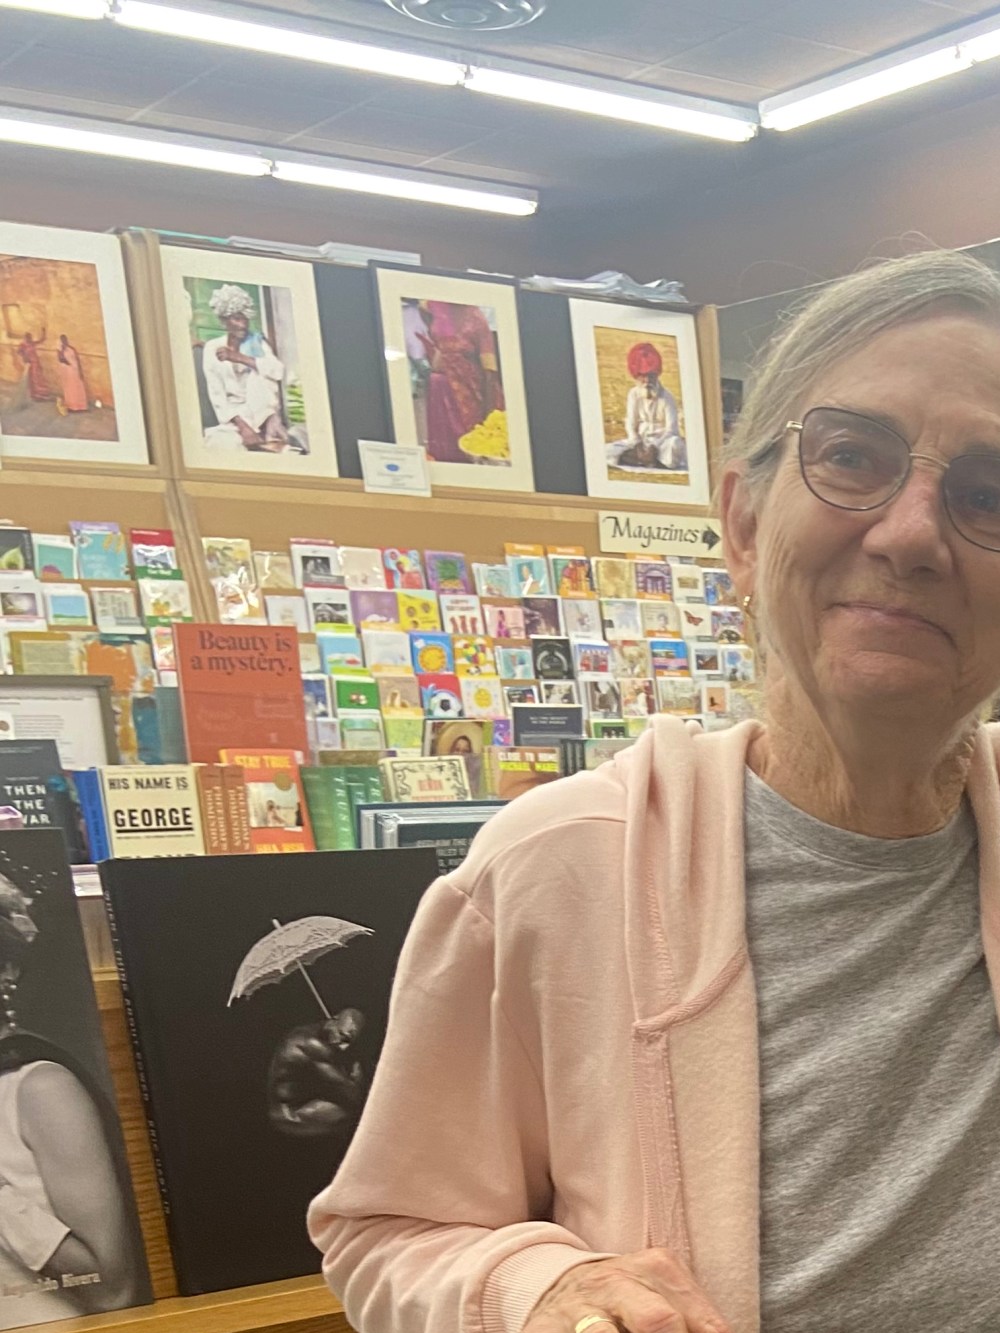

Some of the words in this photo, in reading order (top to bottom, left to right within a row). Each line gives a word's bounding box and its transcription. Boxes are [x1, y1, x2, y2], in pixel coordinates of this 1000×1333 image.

[602, 516, 700, 548] Magazines
[198, 630, 269, 656] Beauty
[274, 632, 292, 652] is
[190, 655, 203, 670] a
[207, 655, 293, 677] mystery.
[234, 756, 260, 768] STAY
[264, 755, 292, 769] TRUE
[3, 784, 47, 796] THEN
[108, 778, 130, 790] HIS
[135, 777, 172, 789] NAME
[176, 777, 189, 790] IS
[12, 799, 46, 810] THE
[113, 807, 194, 827] GEORGE
